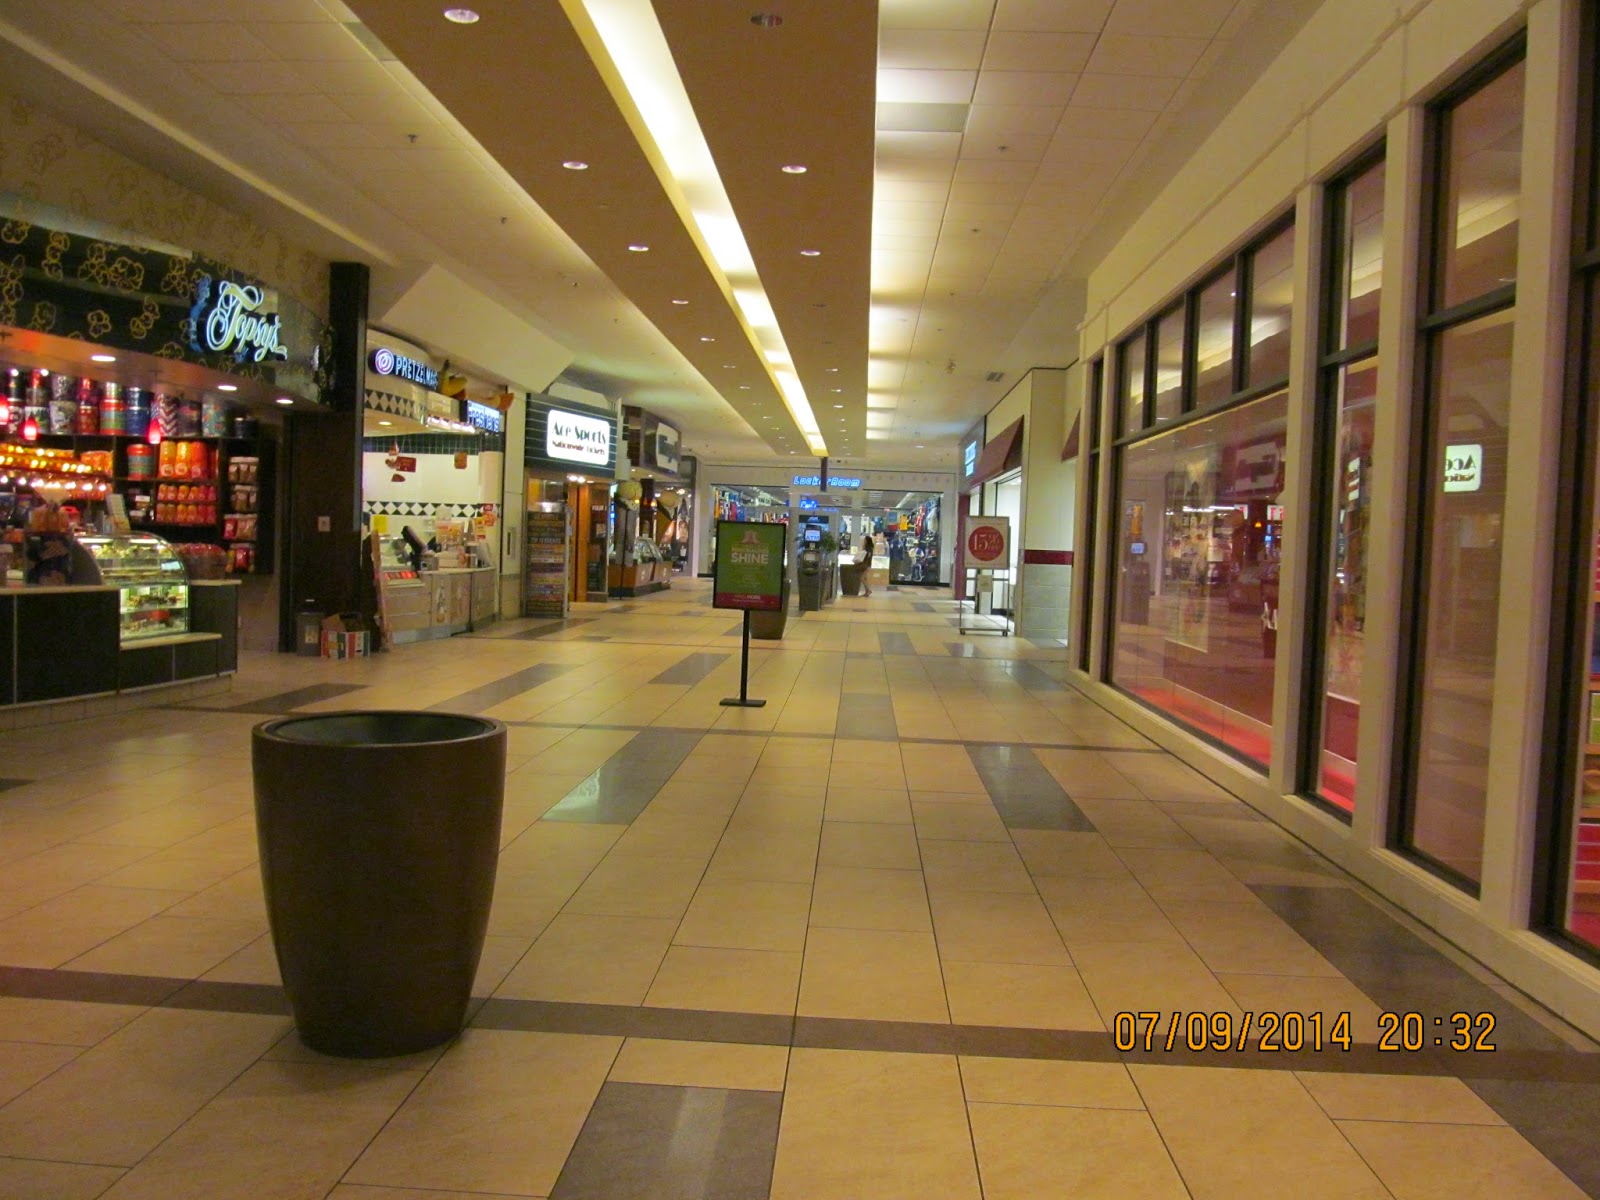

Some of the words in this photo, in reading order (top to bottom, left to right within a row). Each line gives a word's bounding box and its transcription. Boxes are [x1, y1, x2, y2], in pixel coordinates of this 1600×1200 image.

[552, 421, 572, 437] Ace
[574, 425, 607, 446] Sports
[731, 551, 769, 565] SHINE
